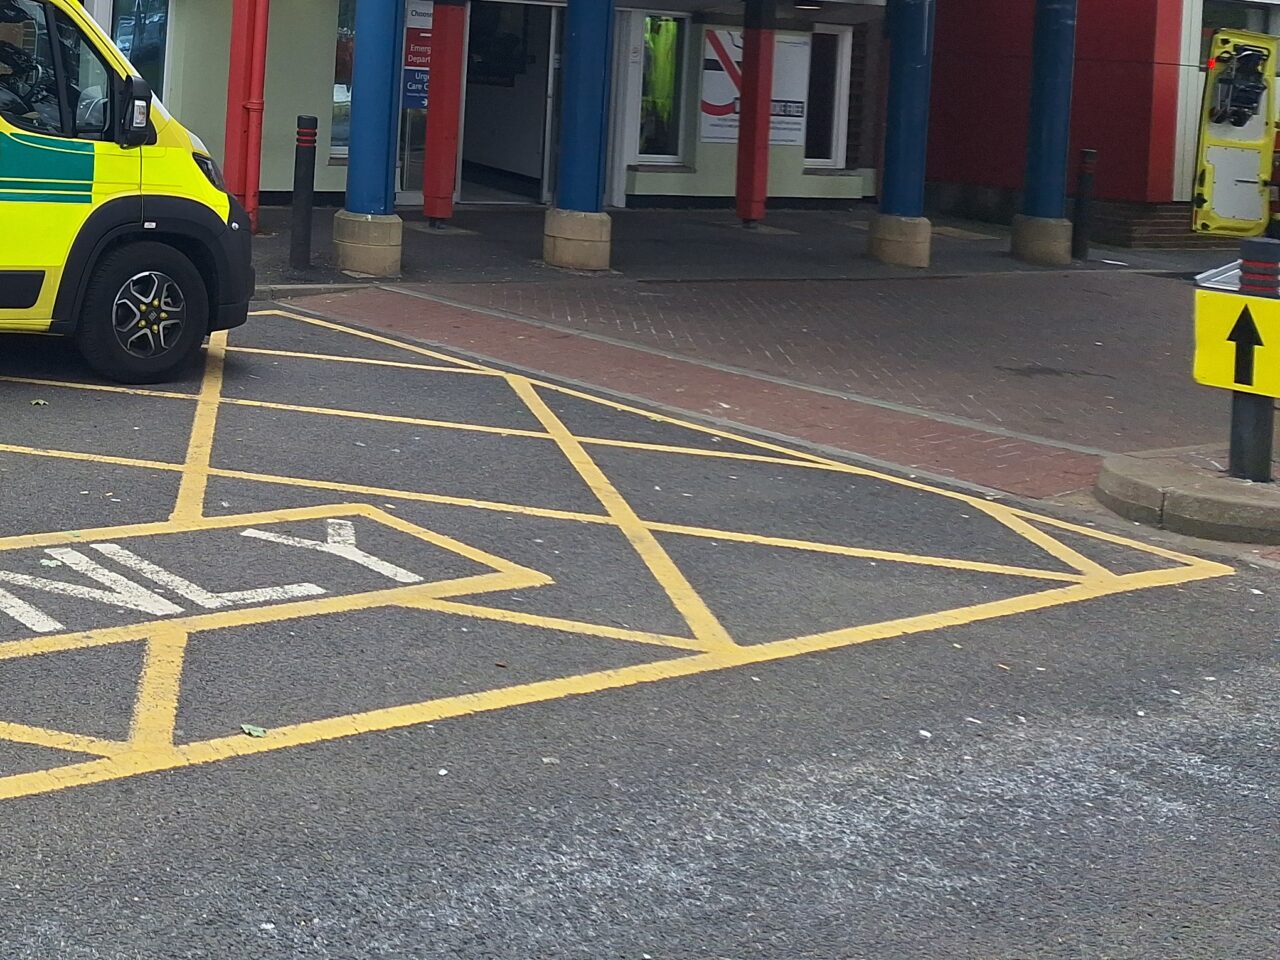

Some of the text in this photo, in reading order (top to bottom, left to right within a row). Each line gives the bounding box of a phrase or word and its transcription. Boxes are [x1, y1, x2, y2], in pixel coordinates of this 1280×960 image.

[410, 44, 431, 55] Emerg
[408, 55, 431, 65] Depart
[407, 81, 423, 90] Care
